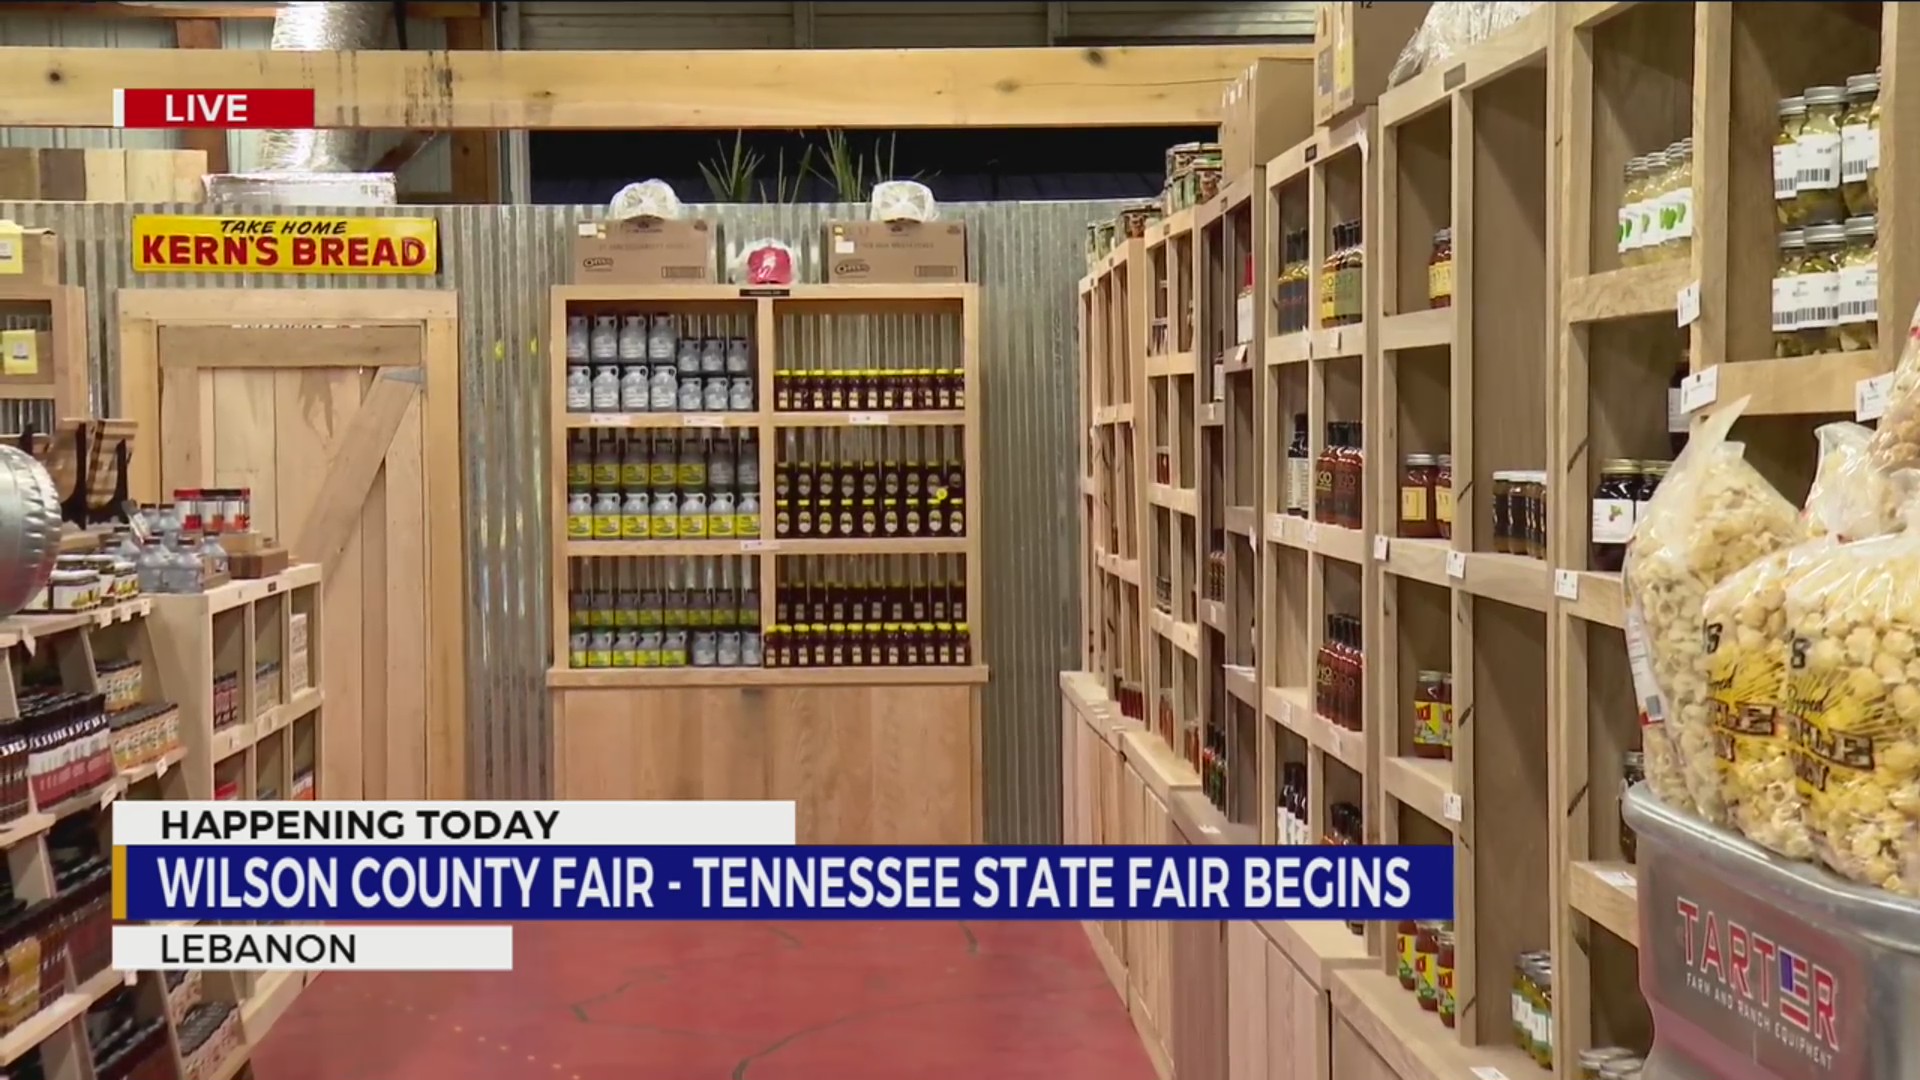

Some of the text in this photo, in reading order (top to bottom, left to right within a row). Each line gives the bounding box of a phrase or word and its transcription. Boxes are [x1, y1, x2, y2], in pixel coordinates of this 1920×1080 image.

[142, 234, 426, 267] KERN'S BREAD
[220, 220, 347, 235] TAKE HOME
[1677, 896, 1839, 1052] TARTER
[1687, 972, 1833, 1071] FARM AND RANCH EQUIPMENT
